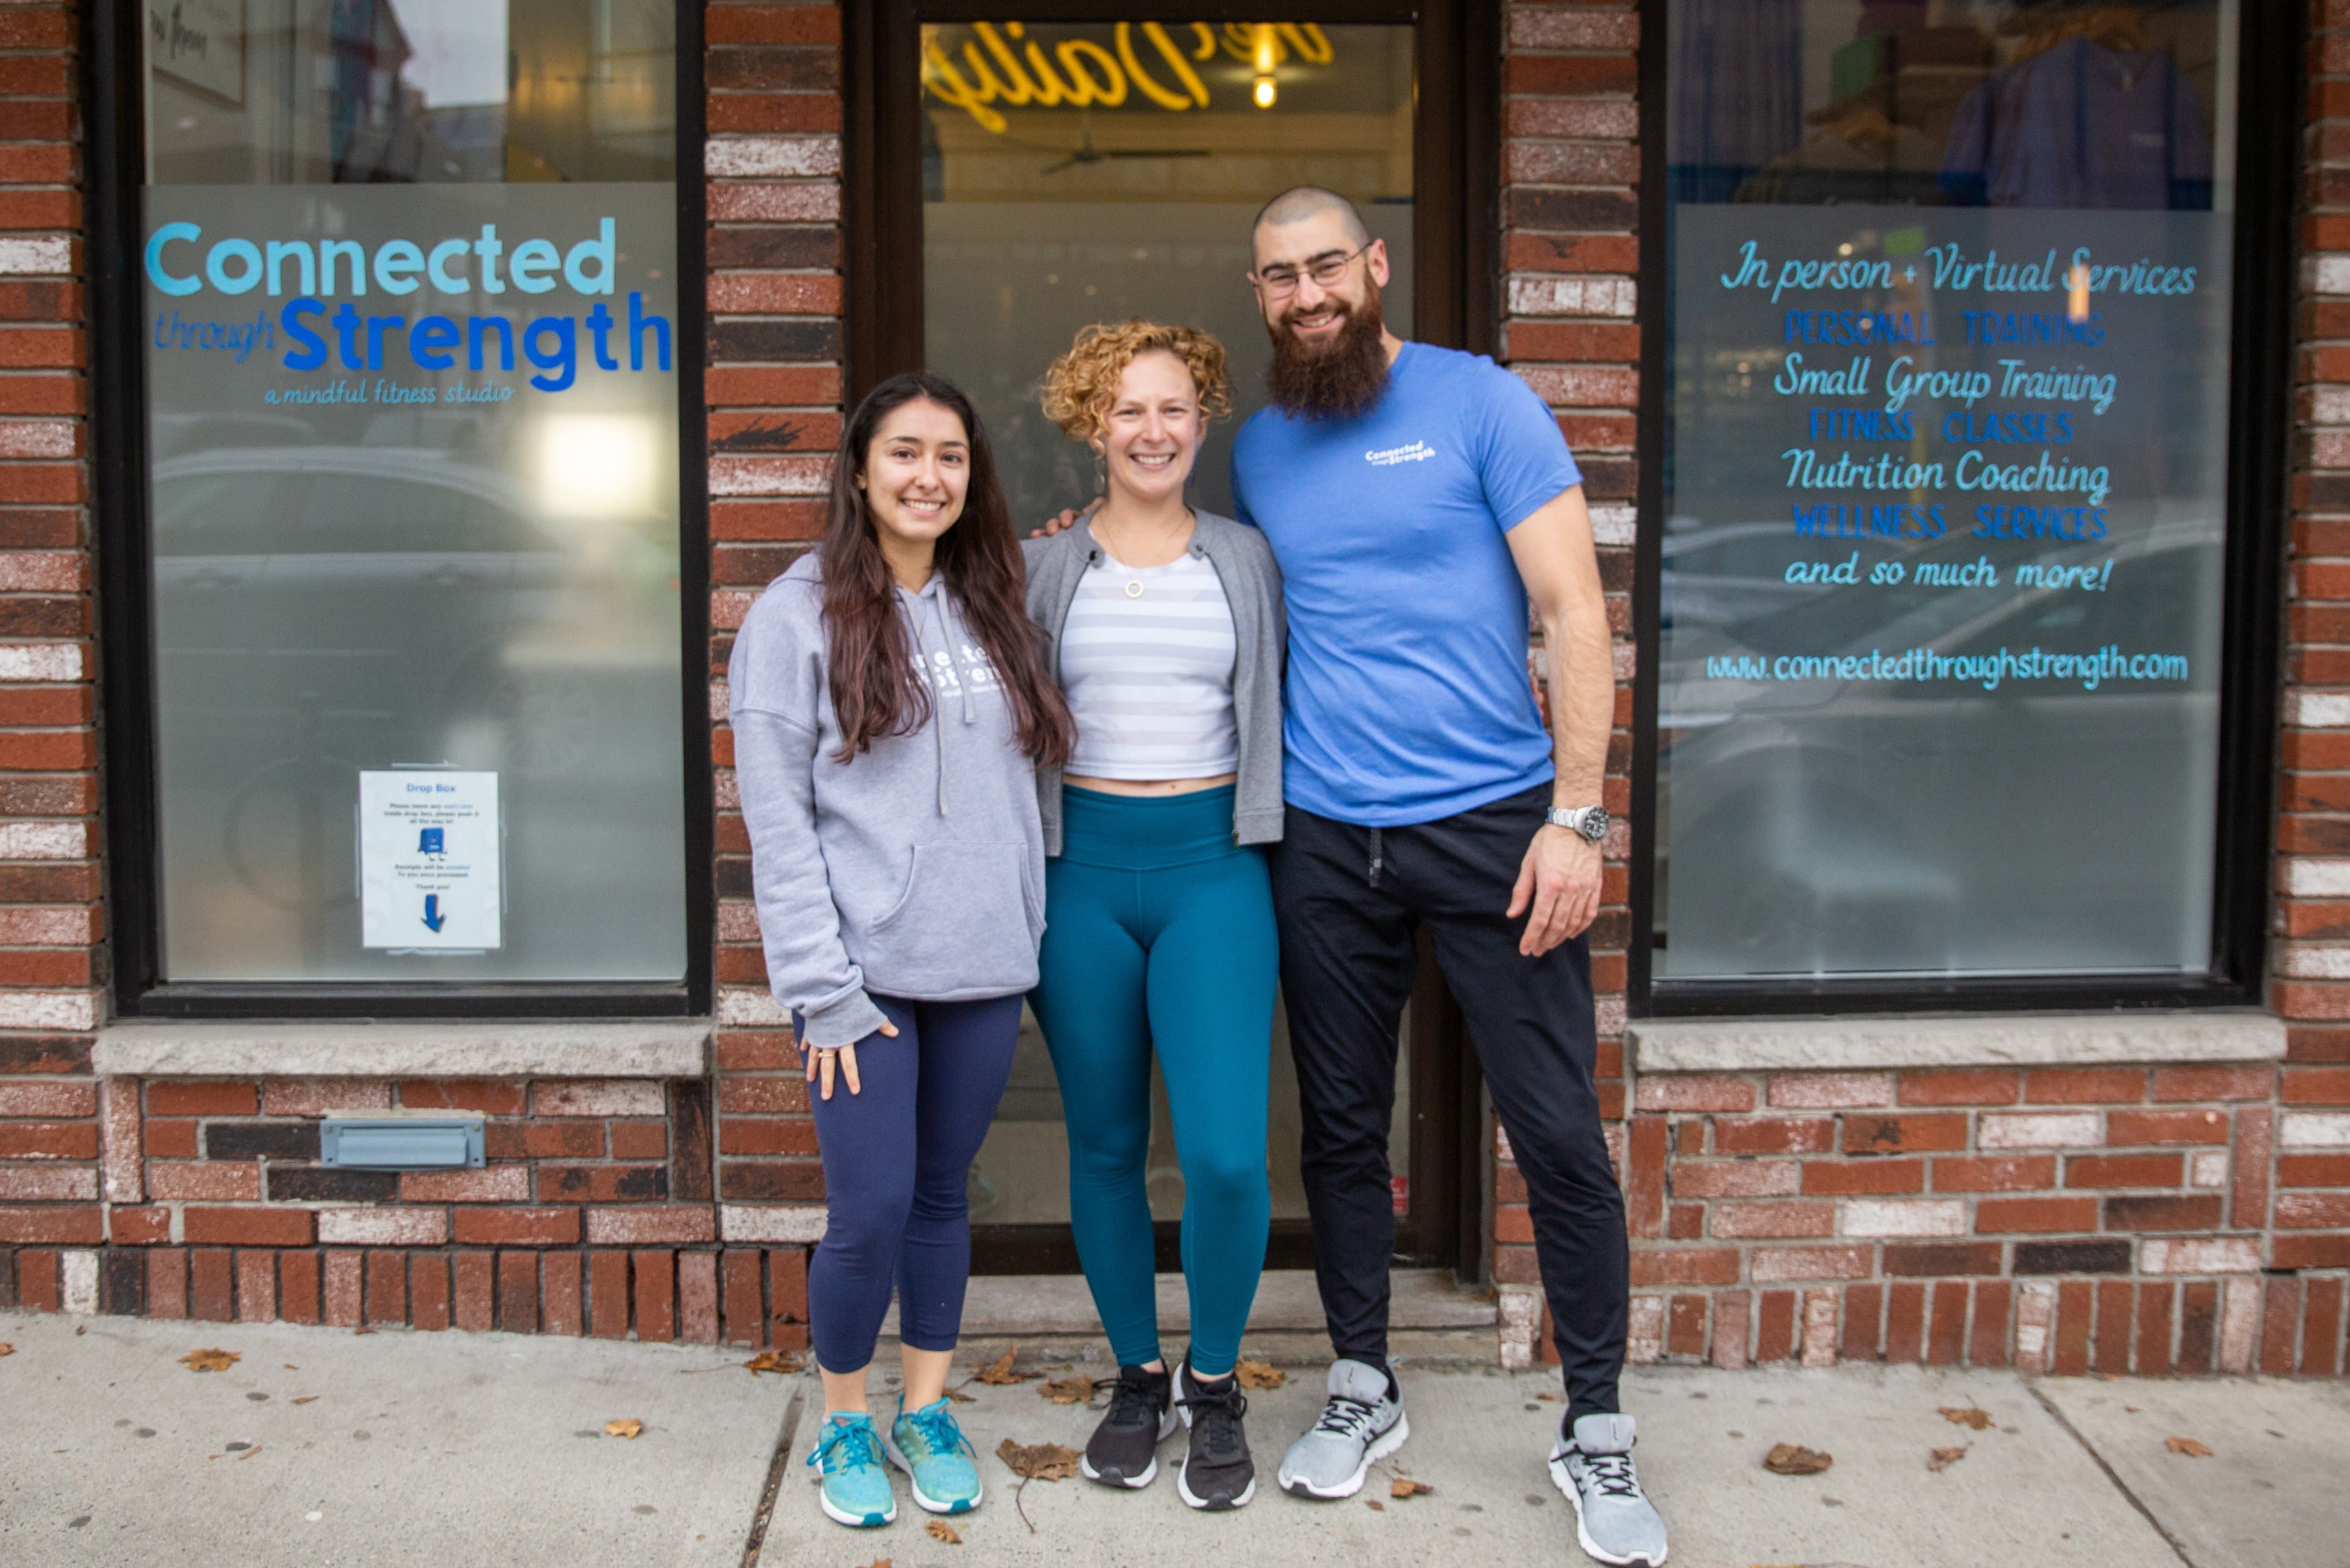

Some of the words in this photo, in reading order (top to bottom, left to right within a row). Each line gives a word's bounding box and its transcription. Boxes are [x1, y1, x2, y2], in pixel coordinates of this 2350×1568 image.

[143, 217, 615, 297] Connected
[1721, 241, 1773, 290] In
[1772, 258, 1894, 303] person
[1903, 267, 1917, 283] +
[1926, 242, 2055, 293] Virtual
[2062, 248, 2197, 295] Services
[154, 310, 275, 363] through
[281, 292, 672, 392] Strength
[1786, 311, 1936, 346] PERSONAL
[1962, 311, 2105, 346] TRAINING
[265, 391, 280, 404] a
[284, 381, 368, 404] mindful
[375, 379, 436, 403] fitness
[445, 382, 515, 403] studio
[1775, 353, 1871, 395] Small
[1887, 356, 1990, 414] Group
[1998, 360, 2116, 415] Training
[1810, 409, 1914, 440] FITNESS
[1943, 412, 2073, 444] CLASSES
[1782, 449, 1947, 489] Nutrition
[1956, 450, 2111, 506] Coaching
[1793, 505, 1948, 539] WELLNESS
[1974, 505, 2108, 540] SERVICES
[1784, 551, 1861, 585] and
[1870, 561, 1905, 584] so
[1914, 557, 1999, 589] much
[2015, 560, 2114, 591] more!
[1707, 645, 2188, 690] www.connectedthroughstrength.com
[407, 783, 433, 794] Drop
[436, 783, 456, 792] Box
